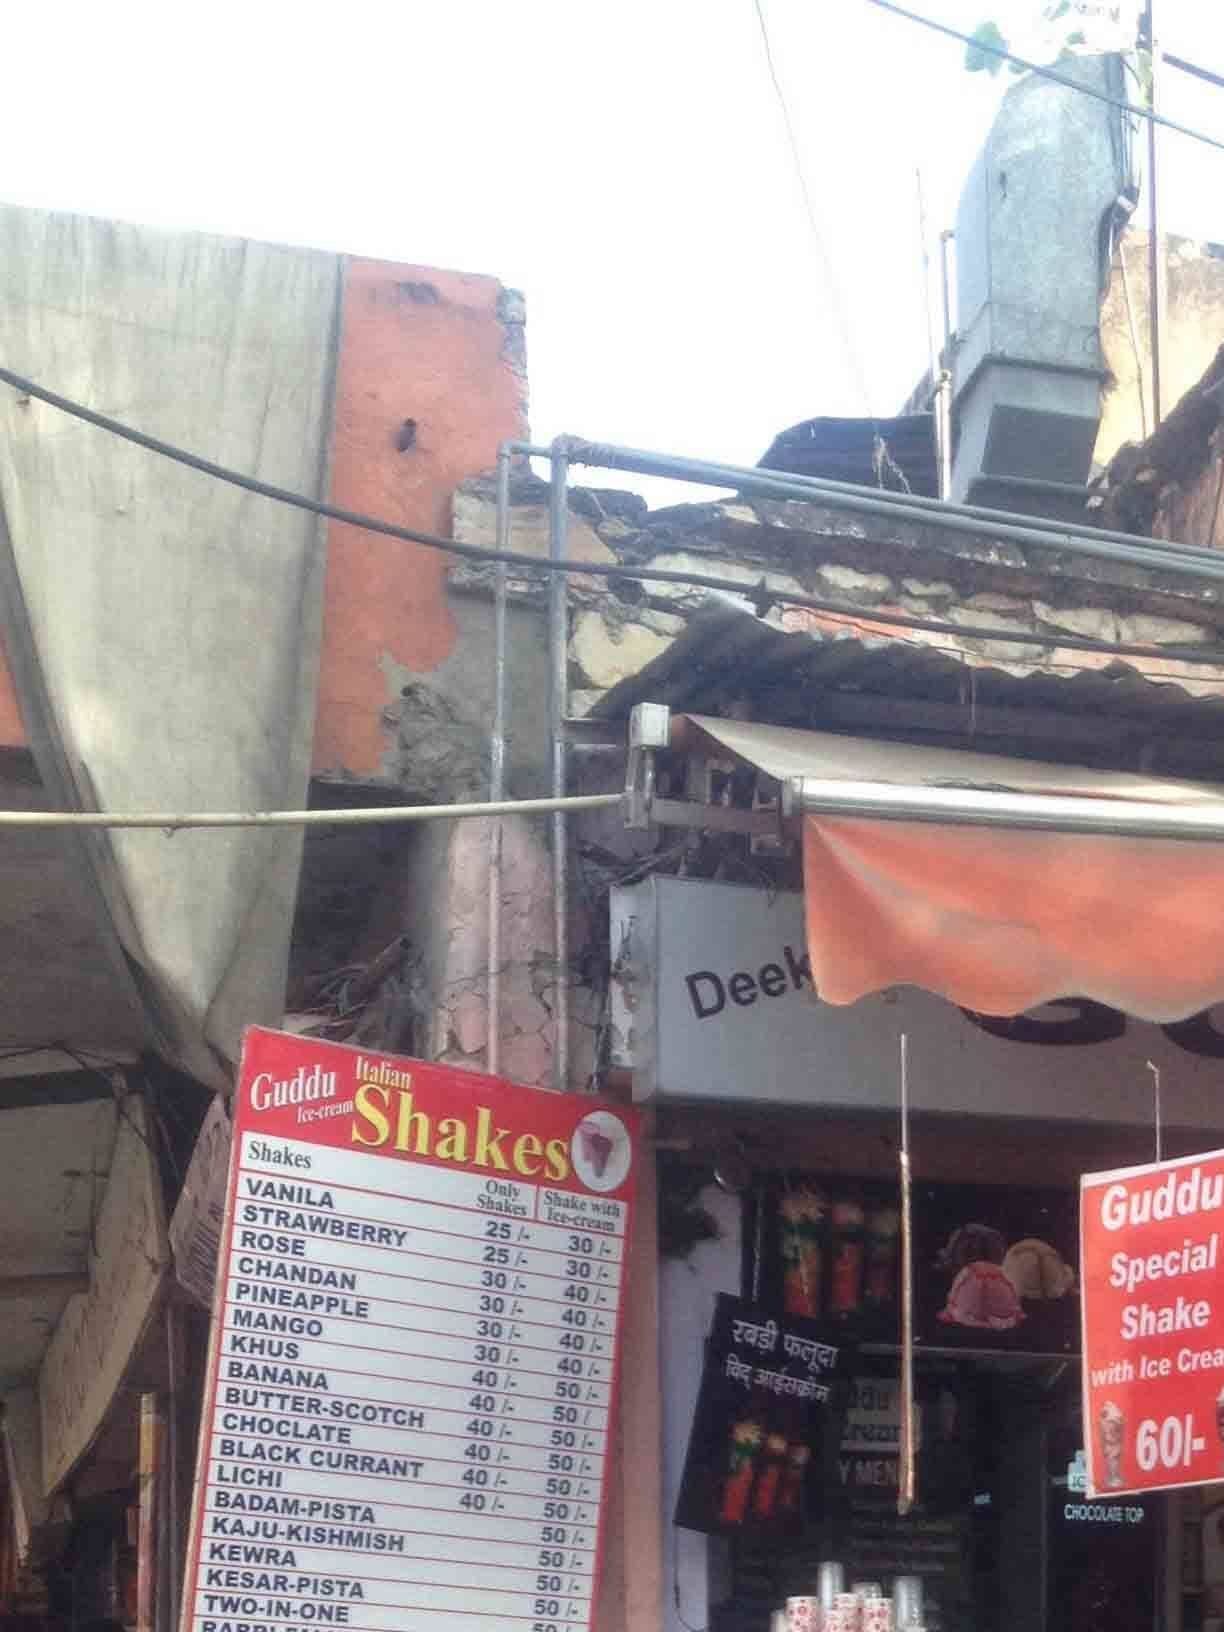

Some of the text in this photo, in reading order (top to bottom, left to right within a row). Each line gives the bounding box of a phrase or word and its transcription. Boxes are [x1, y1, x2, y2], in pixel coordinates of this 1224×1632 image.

[250, 1055, 411, 1111] Guddu Italian
[297, 1082, 571, 1182] Ice-cream Shakes
[246, 1178, 336, 1209] VANILA
[248, 1140, 620, 1218] Shakes Only Shake with
[476, 1195, 527, 1216] Shakes
[1100, 1167, 1224, 1231] Guddu
[242, 1205, 409, 1247] STRAWBERRY
[240, 1230, 306, 1257] ROSE
[238, 1257, 357, 1291] CHANDAN
[1110, 1233, 1218, 1293] Special
[235, 1283, 369, 1318] PINEAPPLE
[233, 1308, 324, 1337] MANGO
[1120, 1296, 1211, 1340] Shake
[230, 1334, 300, 1359] KHUS
[228, 1361, 329, 1390] BANANA
[1090, 1356, 1134, 1389] with
[1139, 1354, 1171, 1380] Ice
[225, 1387, 425, 1429] BUTTER-SCOTCH
[222, 1412, 352, 1445] CHOCLATE
[1135, 1413, 1205, 1471] 60/-
[219, 1439, 424, 1478] BLACK CURRANT
[216, 1465, 283, 1488] LICHI
[214, 1490, 376, 1524] BADAM-PISTA
[211, 1516, 405, 1551] KAJU-KISHMISH
[209, 1543, 297, 1567] KEWRA
[207, 1568, 365, 1599] KESAR-PISTA
[204, 1594, 350, 1623] TWO-IN-ONE
